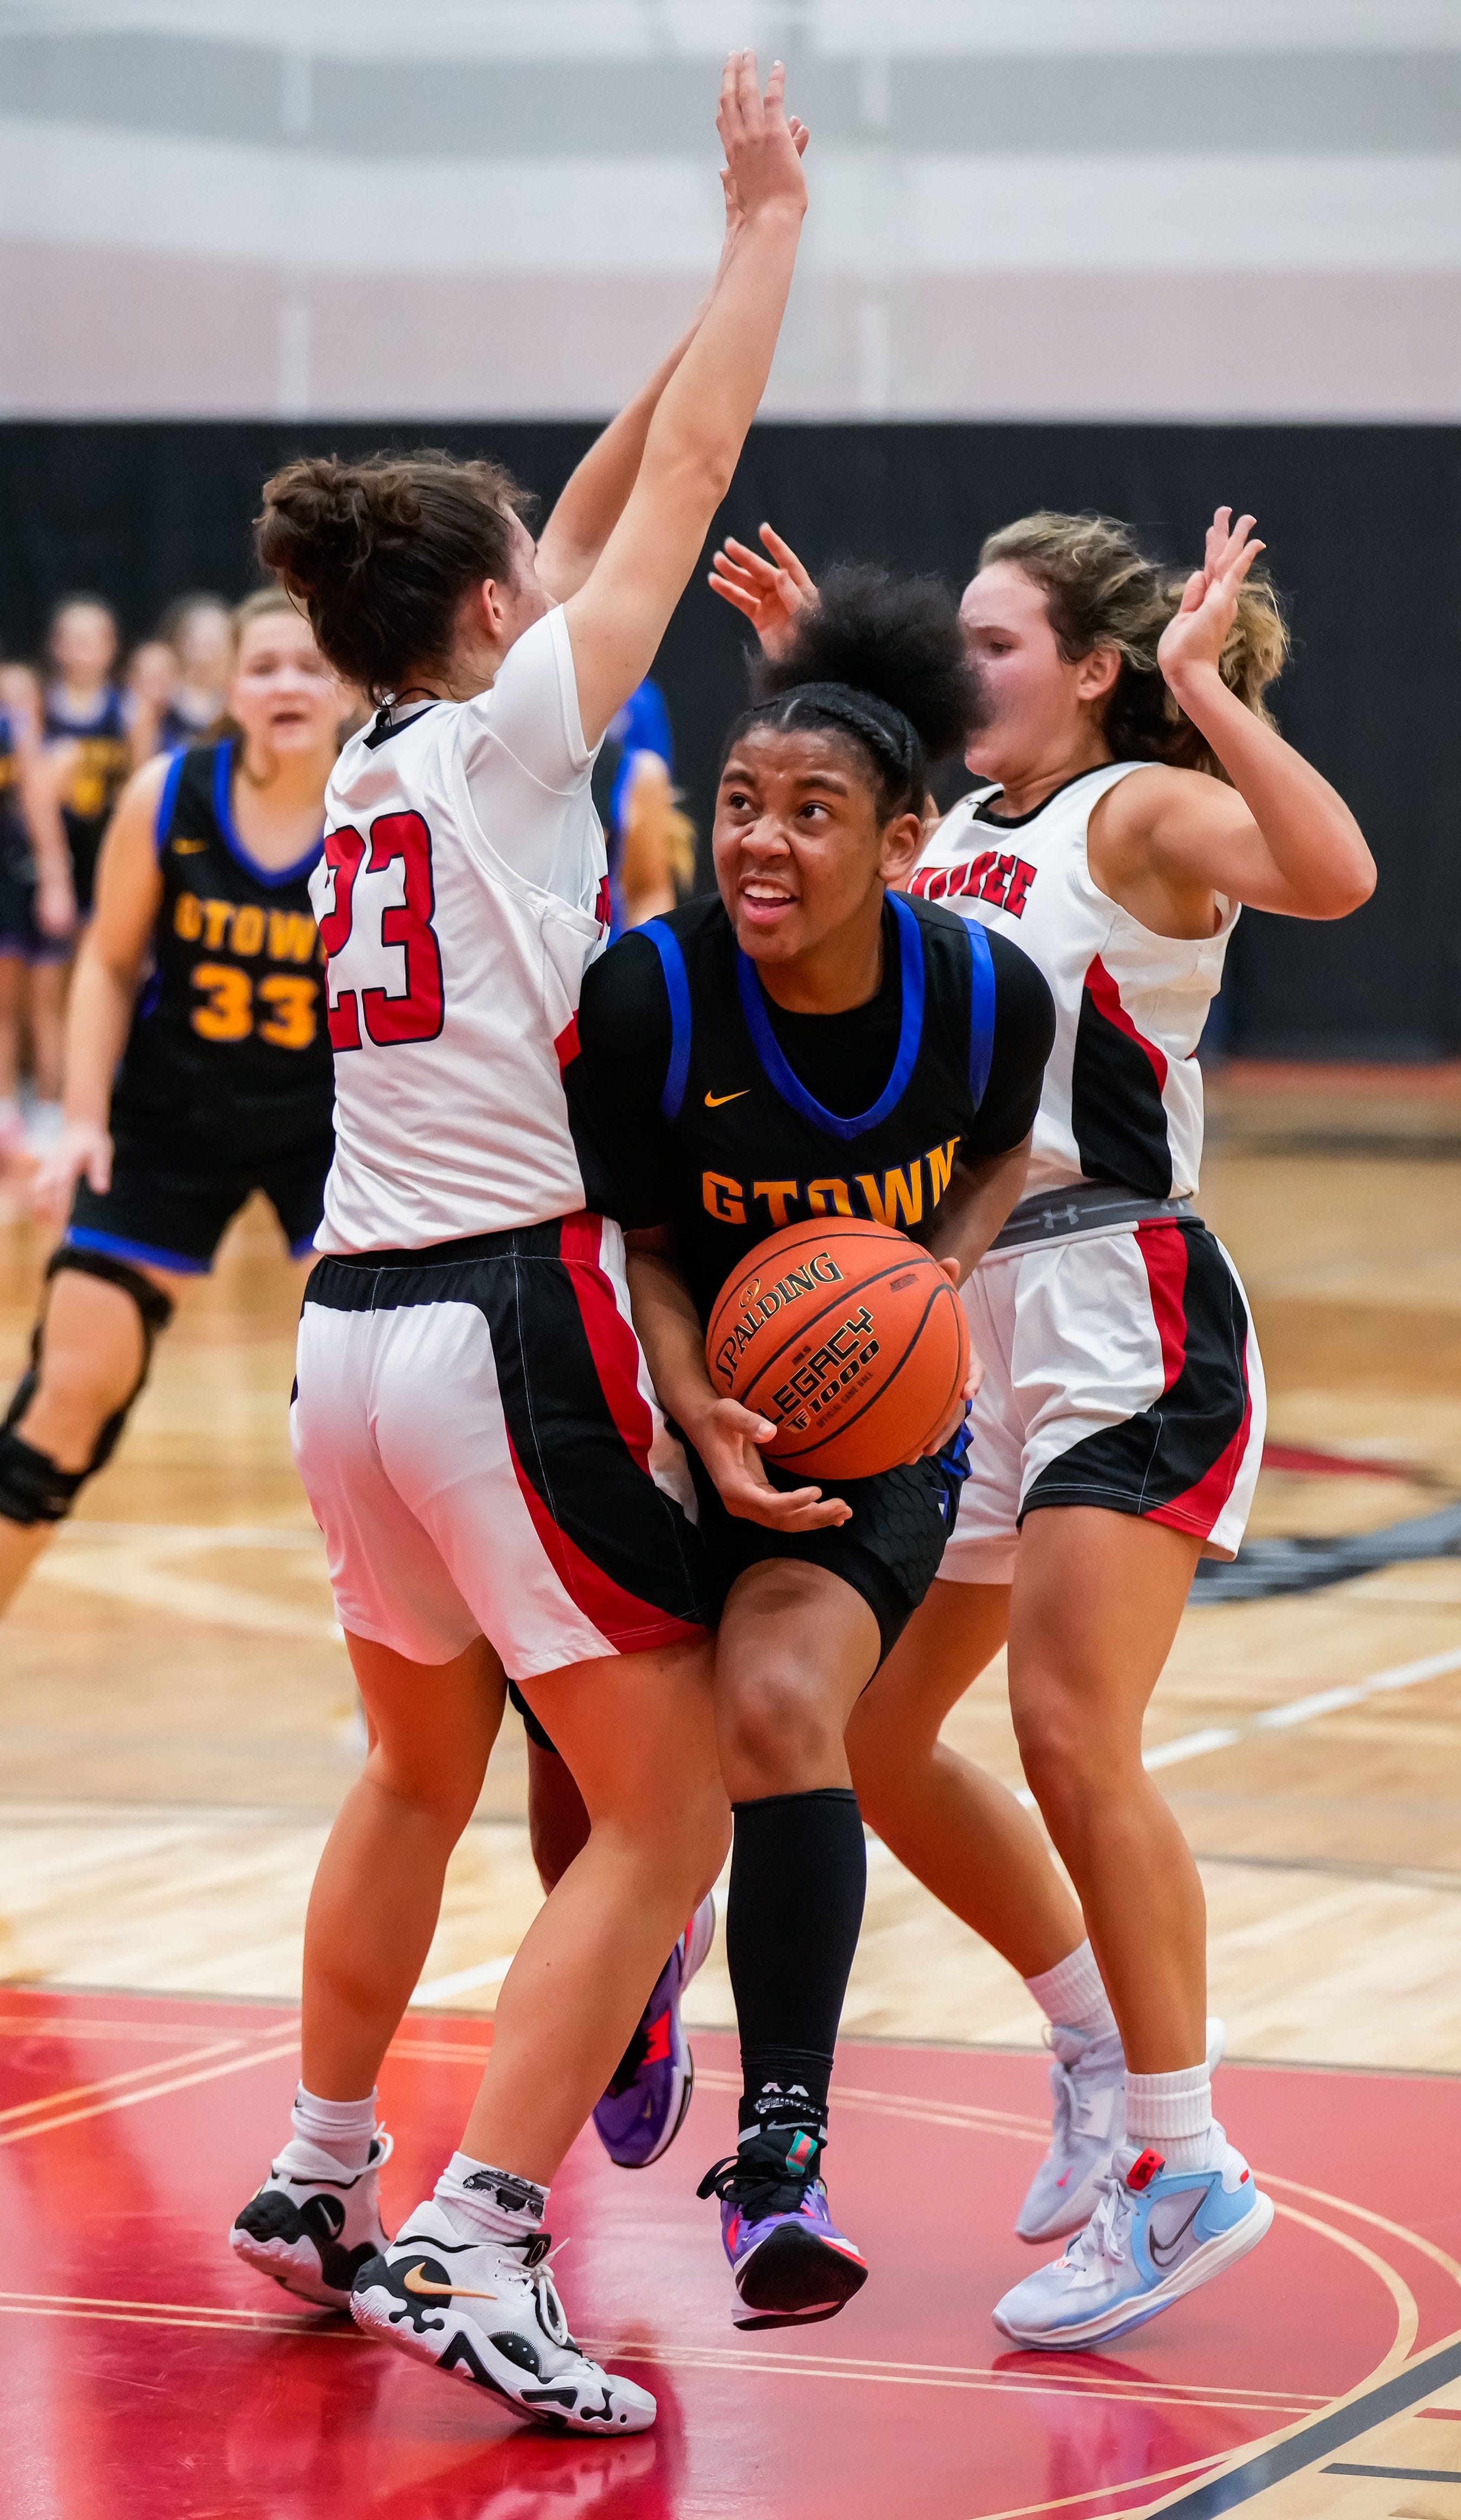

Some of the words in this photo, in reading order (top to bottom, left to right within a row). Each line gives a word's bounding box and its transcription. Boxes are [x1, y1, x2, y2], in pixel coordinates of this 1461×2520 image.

[174, 891, 327, 965] GTOW
[319, 810, 445, 1054] 23
[190, 962, 318, 1050] 33
[702, 1136, 960, 1228] GTOWN
[716, 1251, 845, 1391] SPALDING
[758, 1305, 874, 1425] LEGACY
[807, 1338, 880, 1415] 1000
[816, 1404, 841, 1428] OFFICIAL
[841, 1386, 859, 1405] GAME
[857, 1371, 874, 1388] BALL
